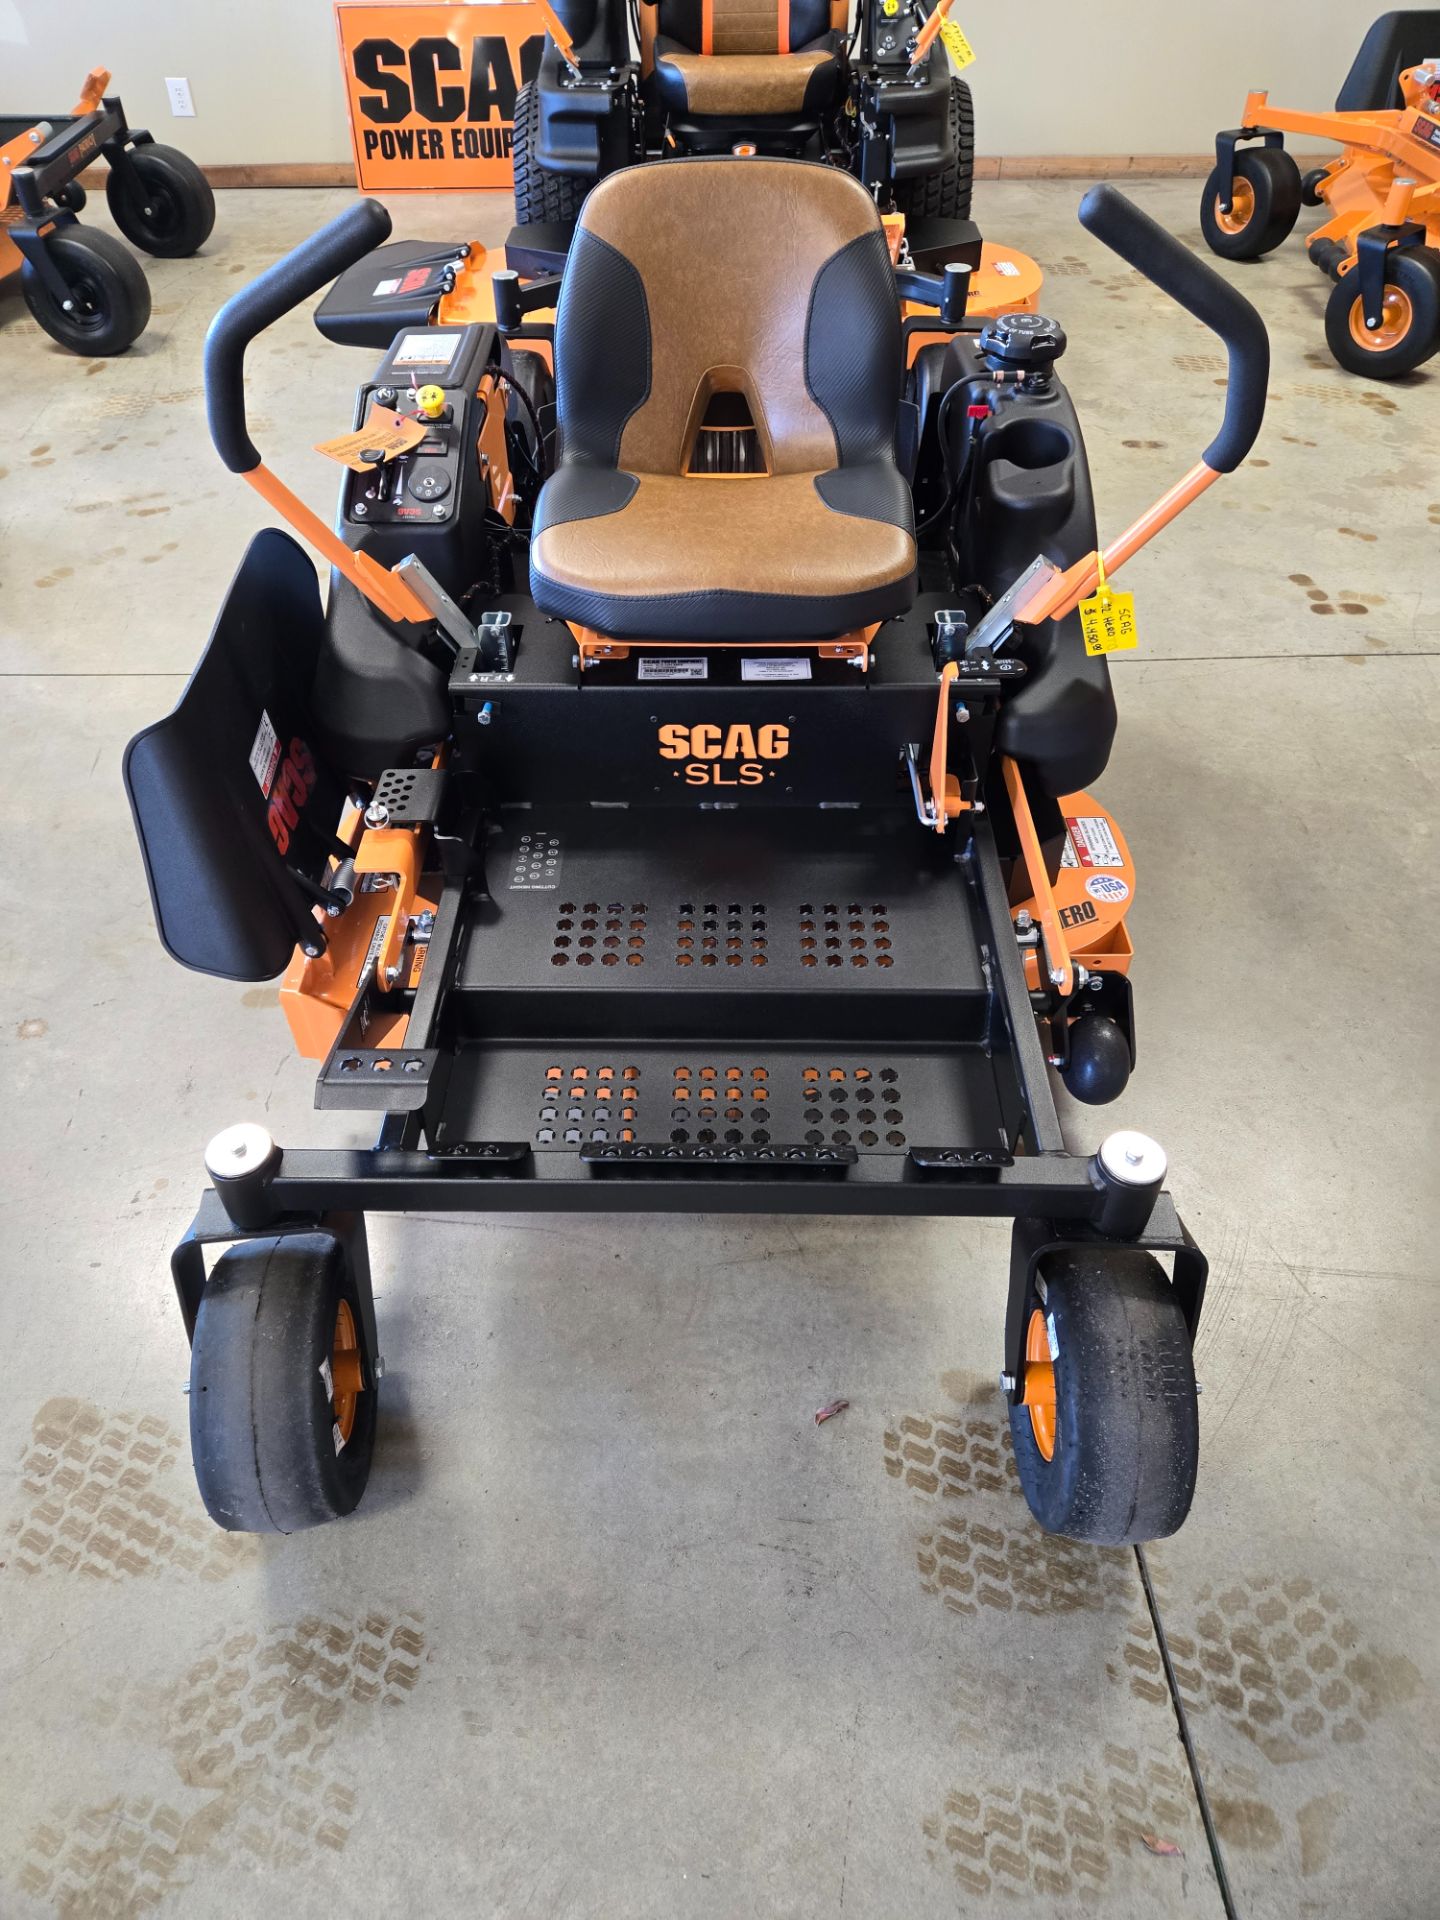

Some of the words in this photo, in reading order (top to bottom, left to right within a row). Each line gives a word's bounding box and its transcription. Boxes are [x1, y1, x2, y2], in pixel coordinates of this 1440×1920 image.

[352, 35, 545, 123] SCA
[363, 129, 445, 160] POWER
[1118, 608, 1133, 636] SCAG
[657, 724, 790, 760] SCAG
[684, 762, 764, 785] SLS
[1071, 825, 1086, 848] DANGER
[1101, 880, 1126, 893] USA
[1058, 900, 1096, 929] ERO
